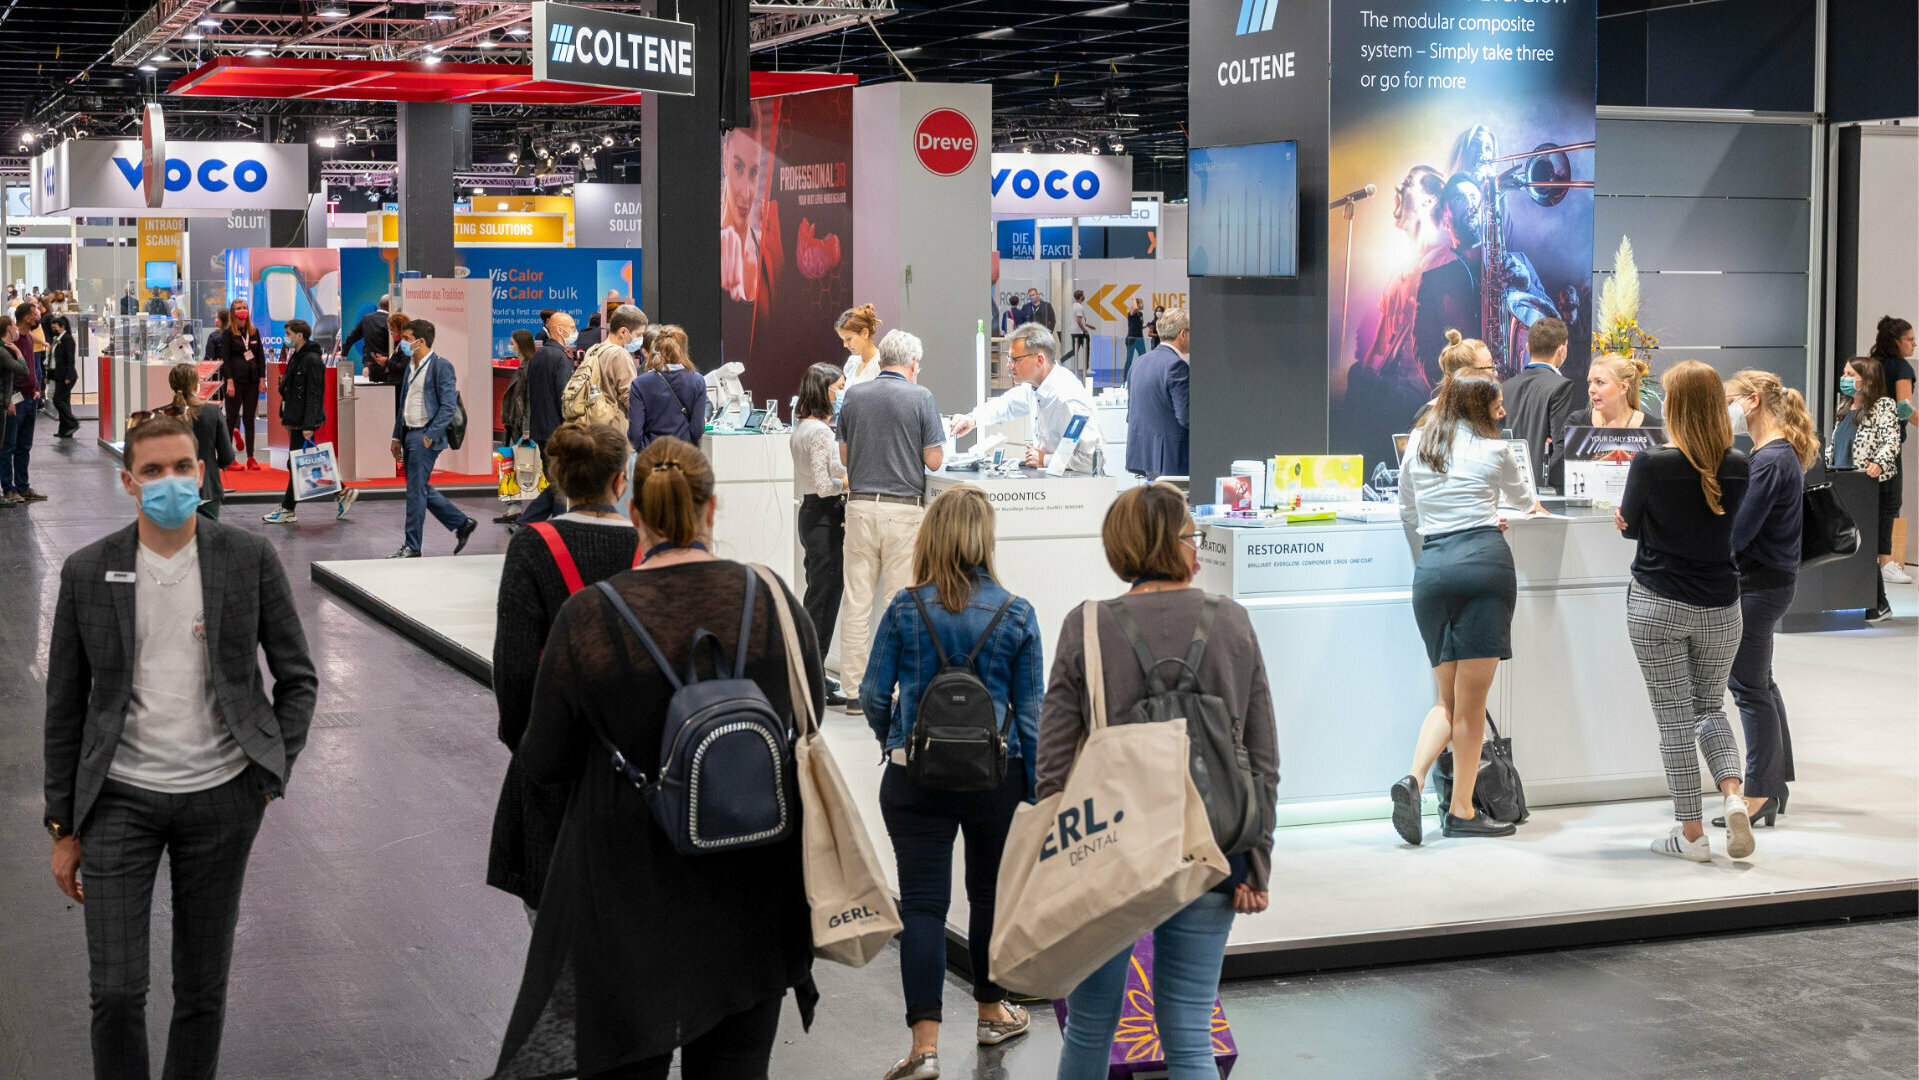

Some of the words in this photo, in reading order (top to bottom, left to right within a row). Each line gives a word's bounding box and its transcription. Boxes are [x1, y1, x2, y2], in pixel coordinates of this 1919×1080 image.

[1360, 10, 1389, 28] The
[1393, 12, 1455, 30] modular
[1458, 16, 1536, 35] composite
[575, 26, 692, 76] COLTENE
[1360, 43, 1412, 62] system
[1430, 43, 1479, 64] Simply
[1482, 43, 1513, 61] take
[1516, 44, 1554, 61] three
[1217, 52, 1295, 86] COLTENE
[1360, 75, 1377, 87] or
[1380, 75, 1400, 91] go
[1404, 71, 1424, 88] for
[1428, 75, 1467, 89] more
[919, 132, 974, 151] Dreve
[112, 157, 268, 193] VOCO
[480, 223, 533, 236] SOLUTIONS
[1012, 233, 1029, 244] DIE
[488, 268, 544, 282] VisCalor
[405, 288, 431, 300] Innovation
[442, 288, 465, 300] Tradition
[548, 286, 578, 300] bulk
[516, 308, 530, 316] first
[1591, 435, 1608, 443] YOUR
[1247, 542, 1324, 556] RESTORATION
[1247, 561, 1272, 569] BRILLIANT
[1273, 560, 1300, 568] EVERGLOW
[1301, 559, 1332, 567] COMPONEER
[1069, 831, 1119, 867] DENTAL
[828, 905, 880, 929] GERL.
